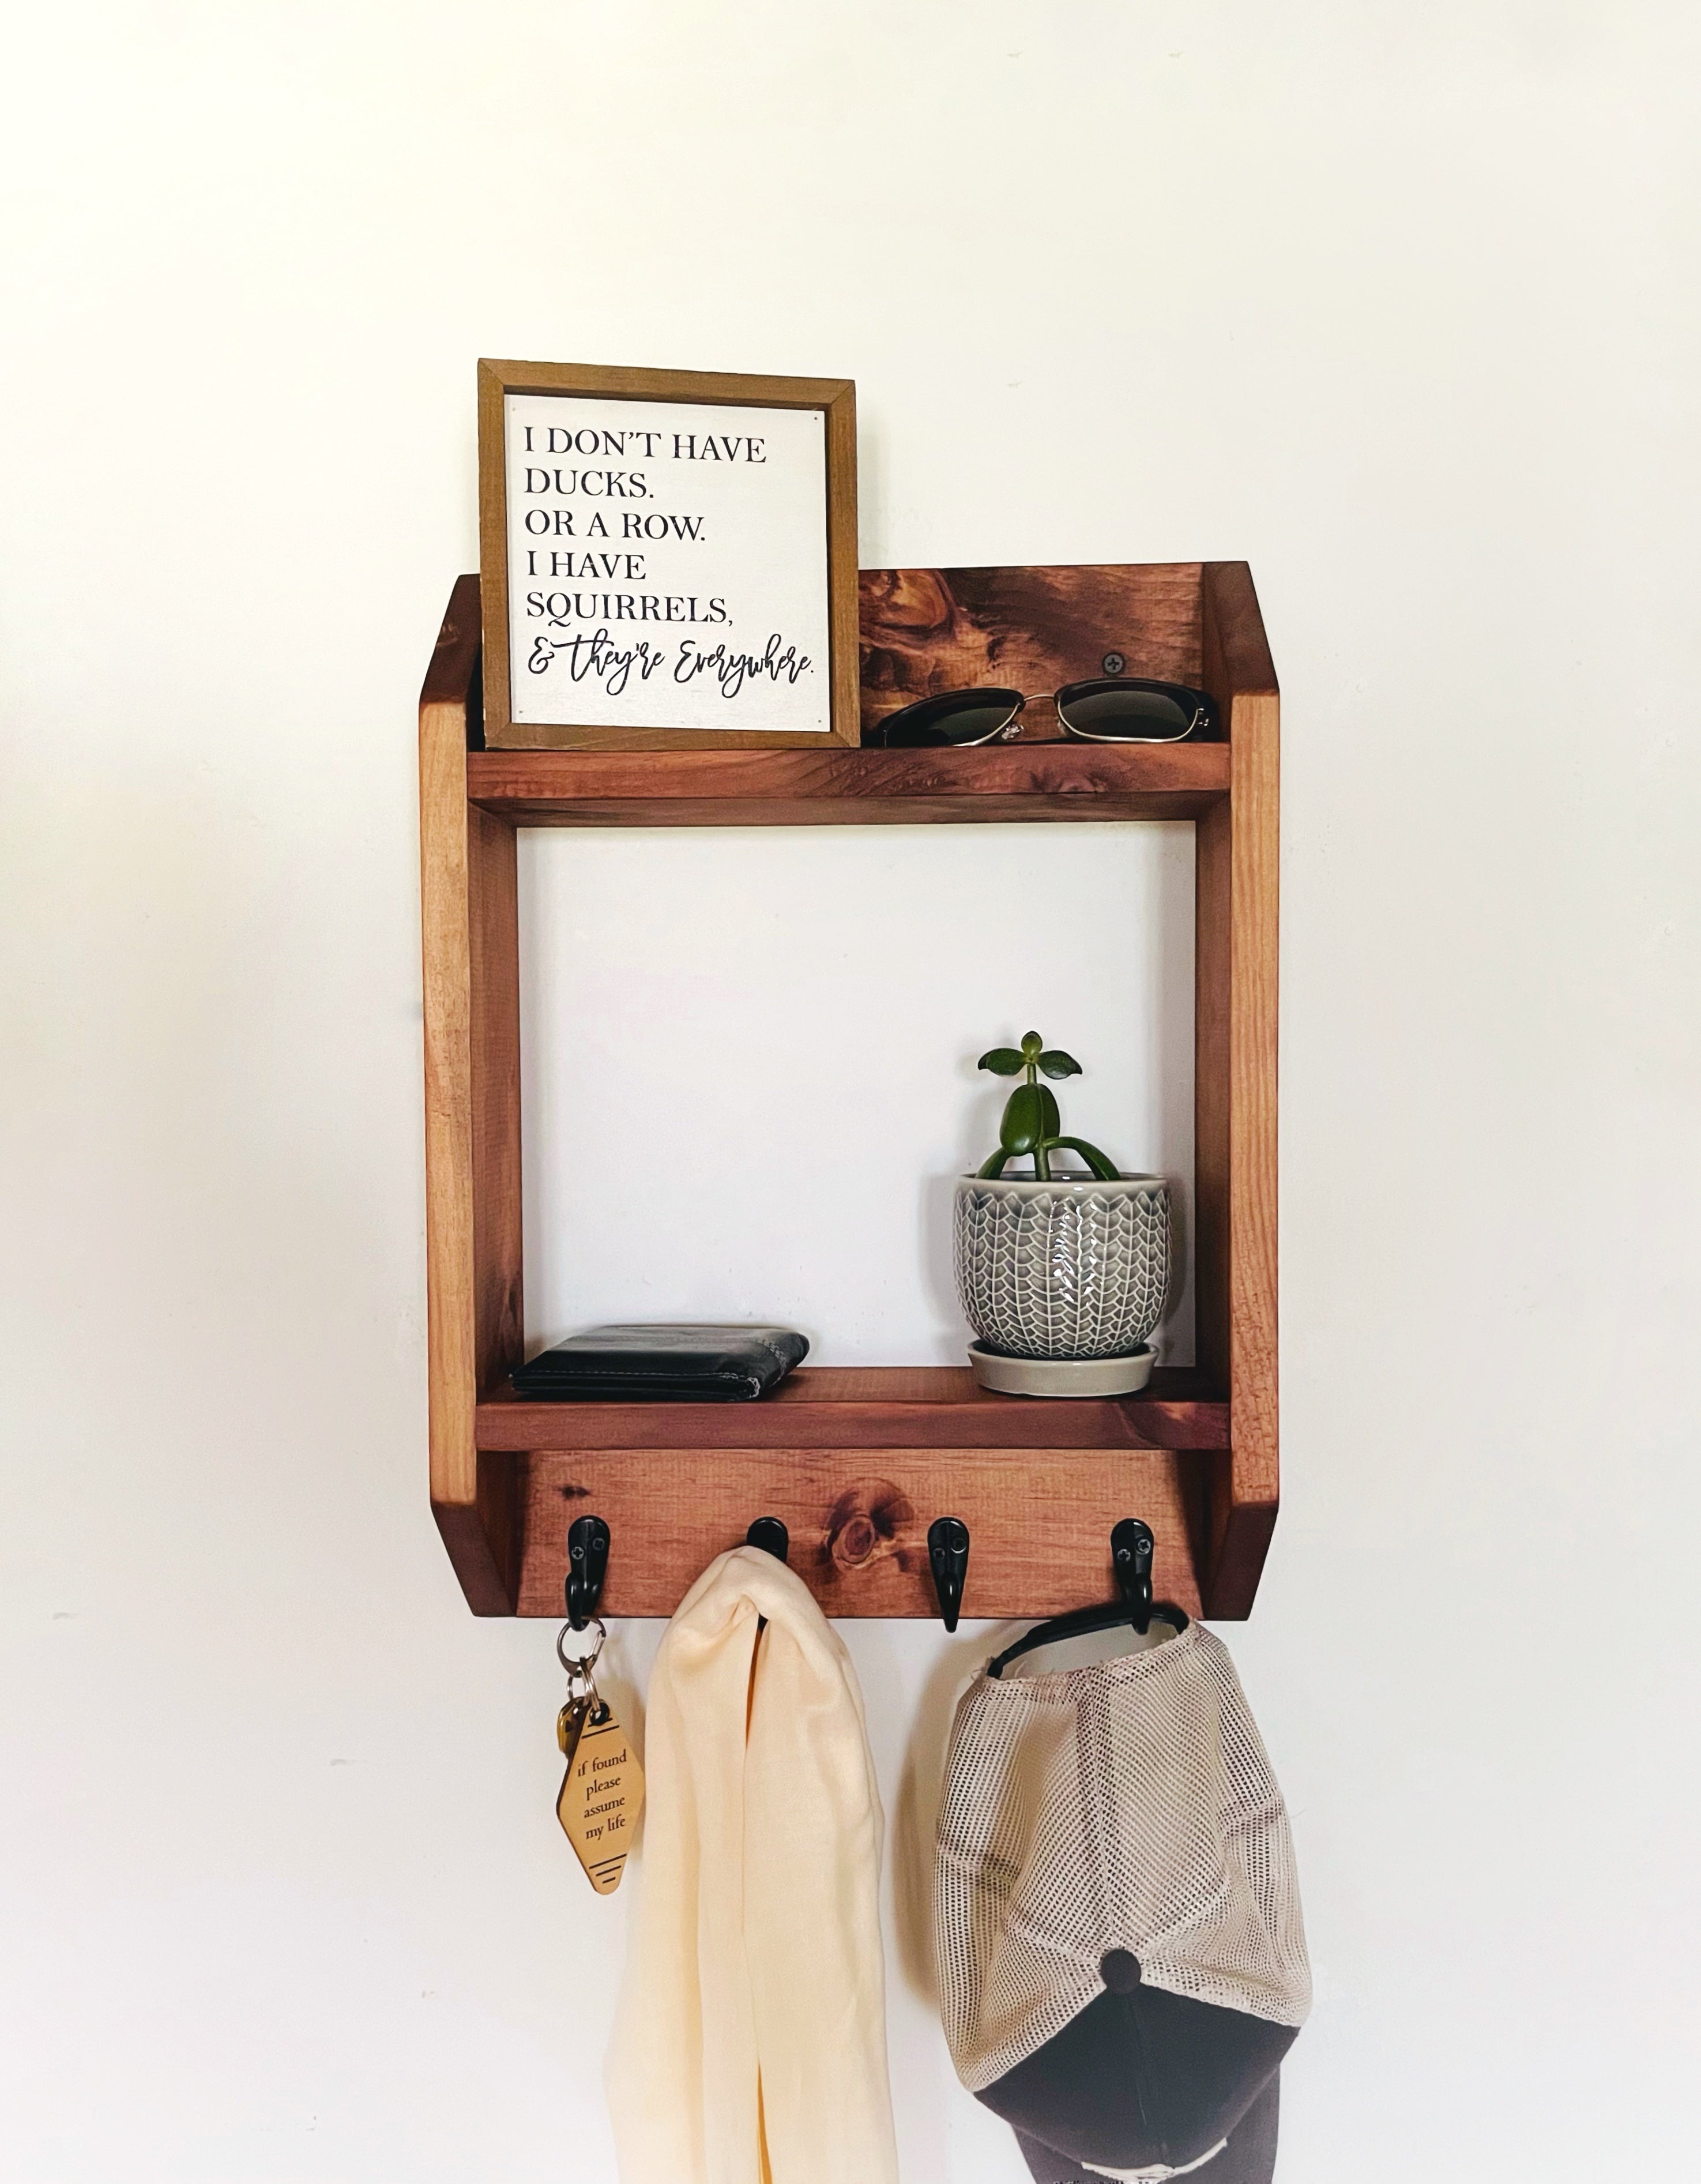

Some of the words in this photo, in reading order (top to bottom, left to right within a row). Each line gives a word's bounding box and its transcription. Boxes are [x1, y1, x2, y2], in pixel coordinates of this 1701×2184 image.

[524, 426, 534, 452] I
[547, 427, 661, 457] DON'T
[672, 434, 766, 463] HAVE
[524, 468, 654, 498] DUCKS.
[525, 509, 577, 536] OR
[586, 512, 609, 537] A
[621, 513, 705, 541] ROW.
[527, 550, 538, 576] I
[550, 551, 646, 580] HAVE
[526, 592, 733, 627] SQUIRRELS,
[528, 636, 555, 674] &
[550, 628, 665, 696] they're
[673, 633, 814, 699] Everywhere.
[578, 1760, 588, 1777] if
[592, 1749, 627, 1772] found
[586, 1777, 621, 1800] please
[584, 1796, 625, 1818] assume
[586, 1826, 604, 1841] my
[607, 1814, 626, 1832] life
